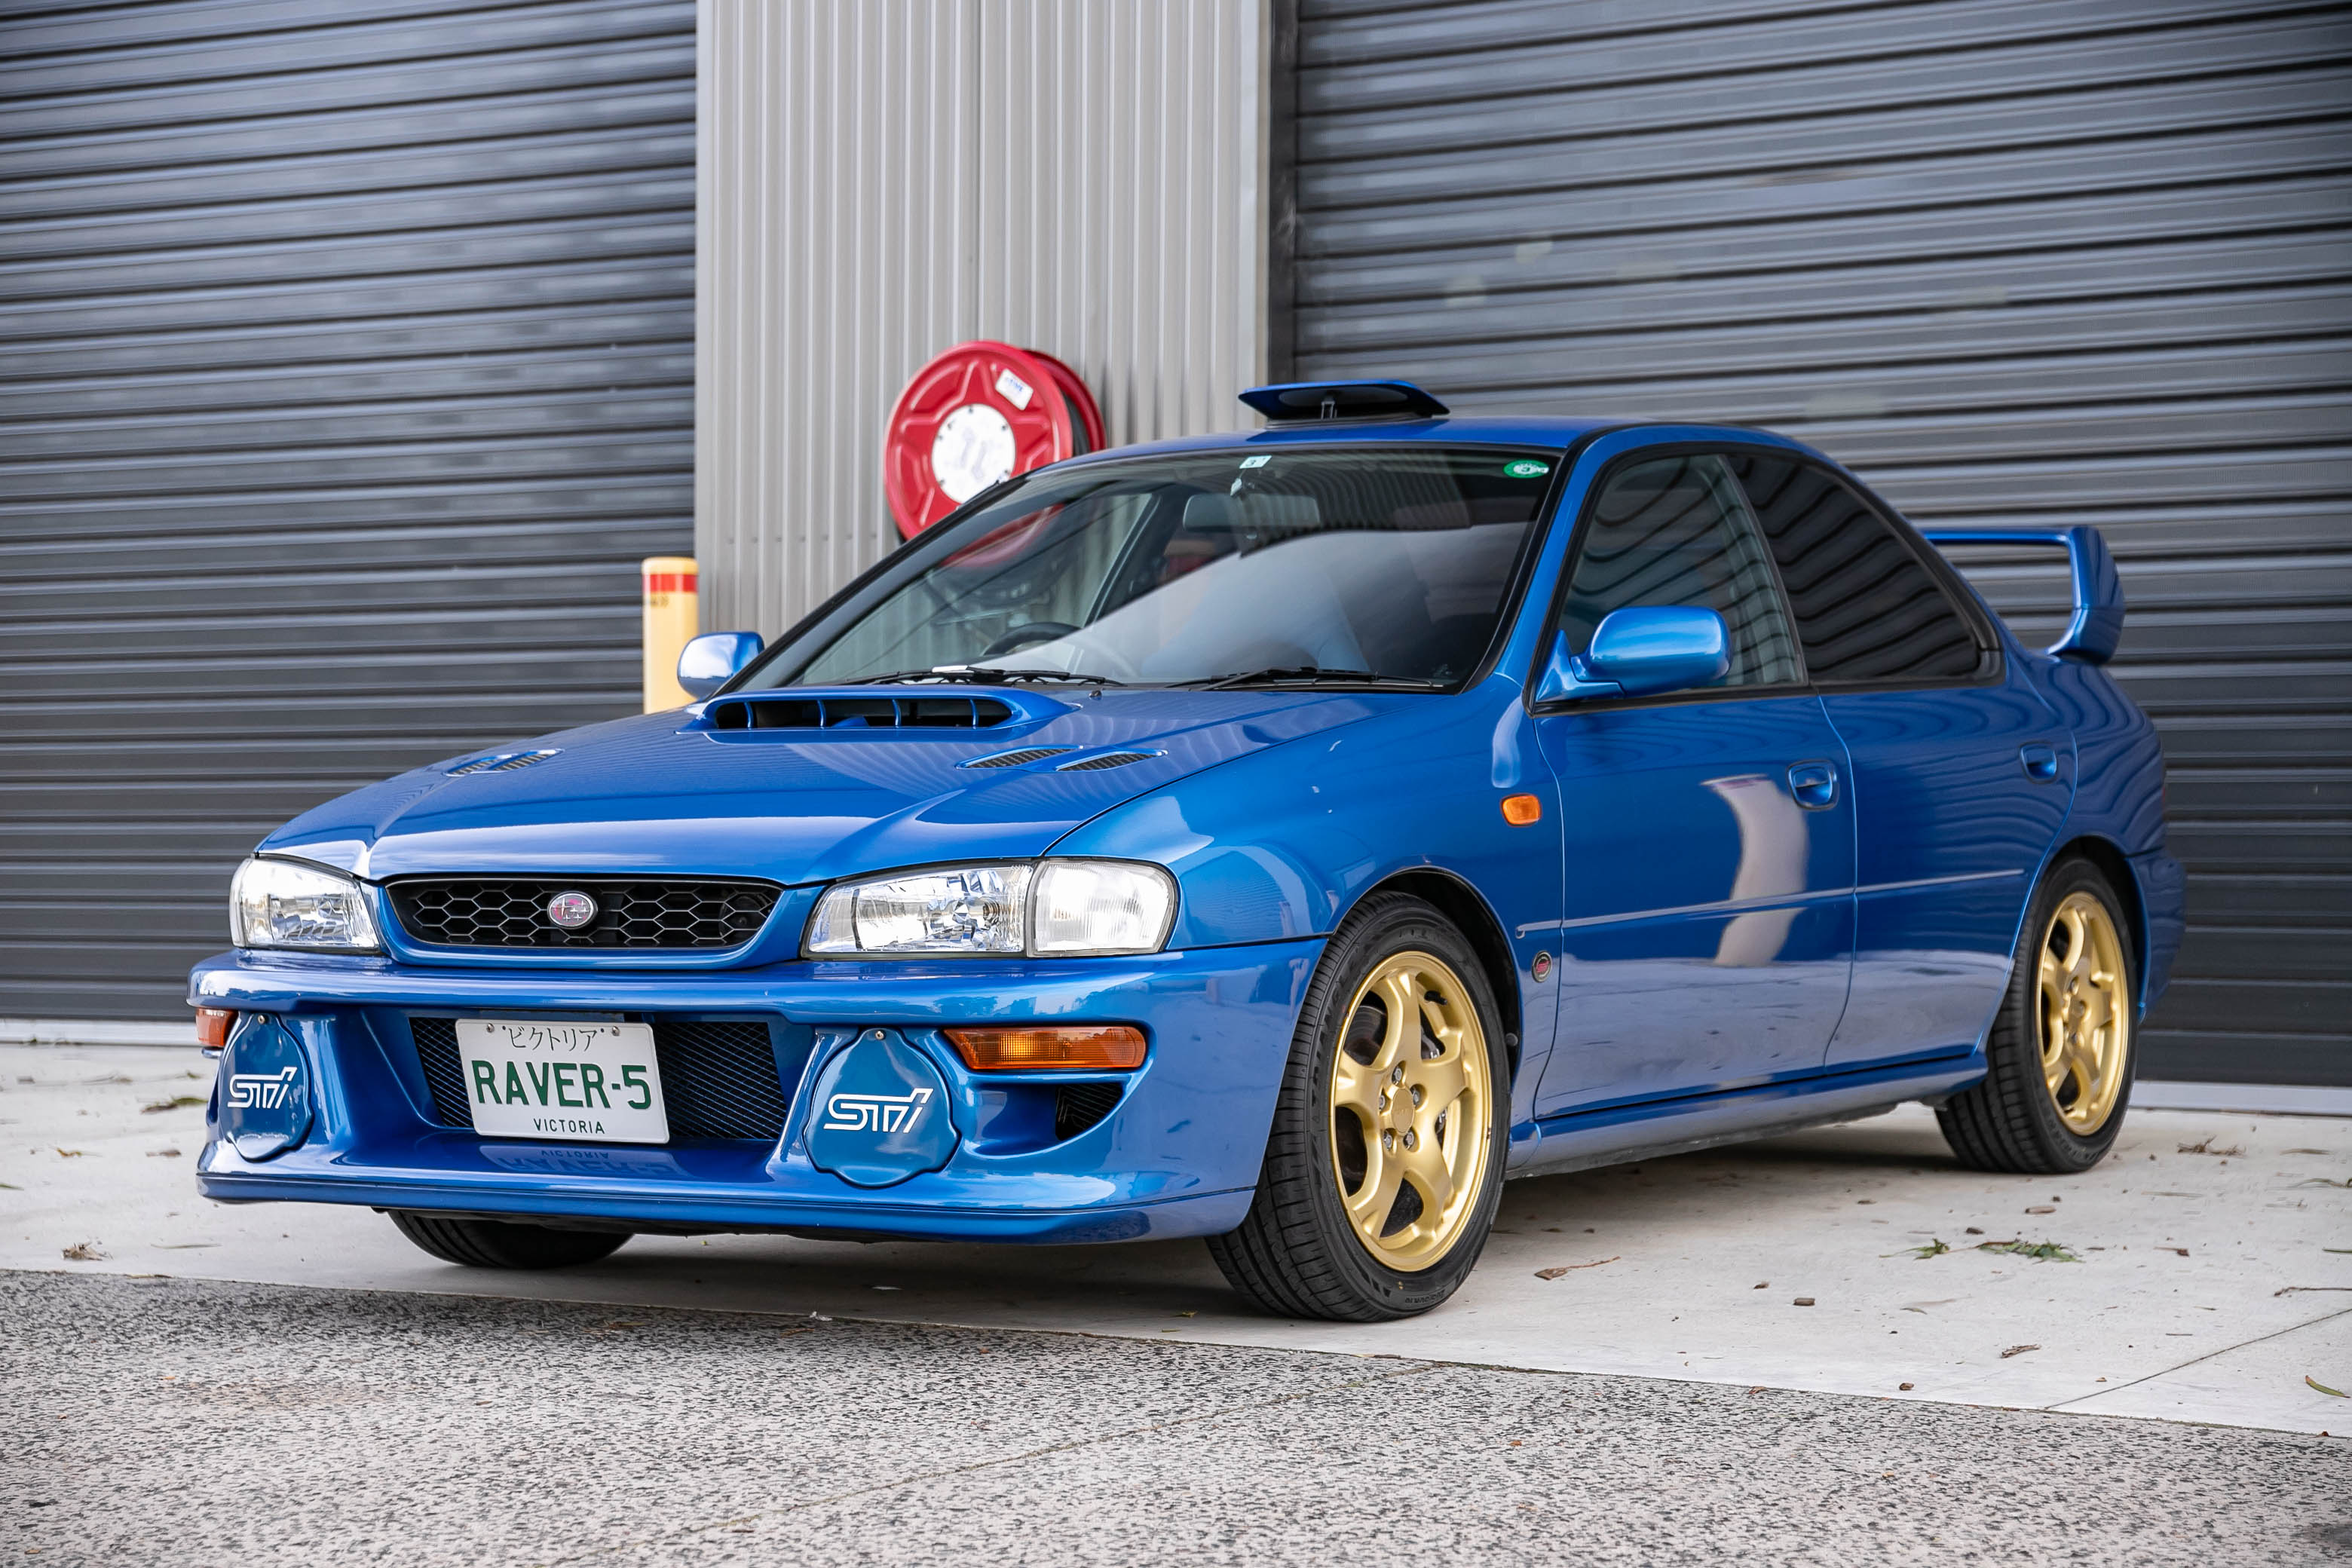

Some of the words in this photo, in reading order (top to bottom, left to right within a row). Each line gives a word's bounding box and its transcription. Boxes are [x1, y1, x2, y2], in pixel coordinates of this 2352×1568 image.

[508, 1025, 598, 1052] ビクトリア
[471, 1060, 652, 1110] RAVER-5
[534, 1118, 605, 1134] VICTORIA
